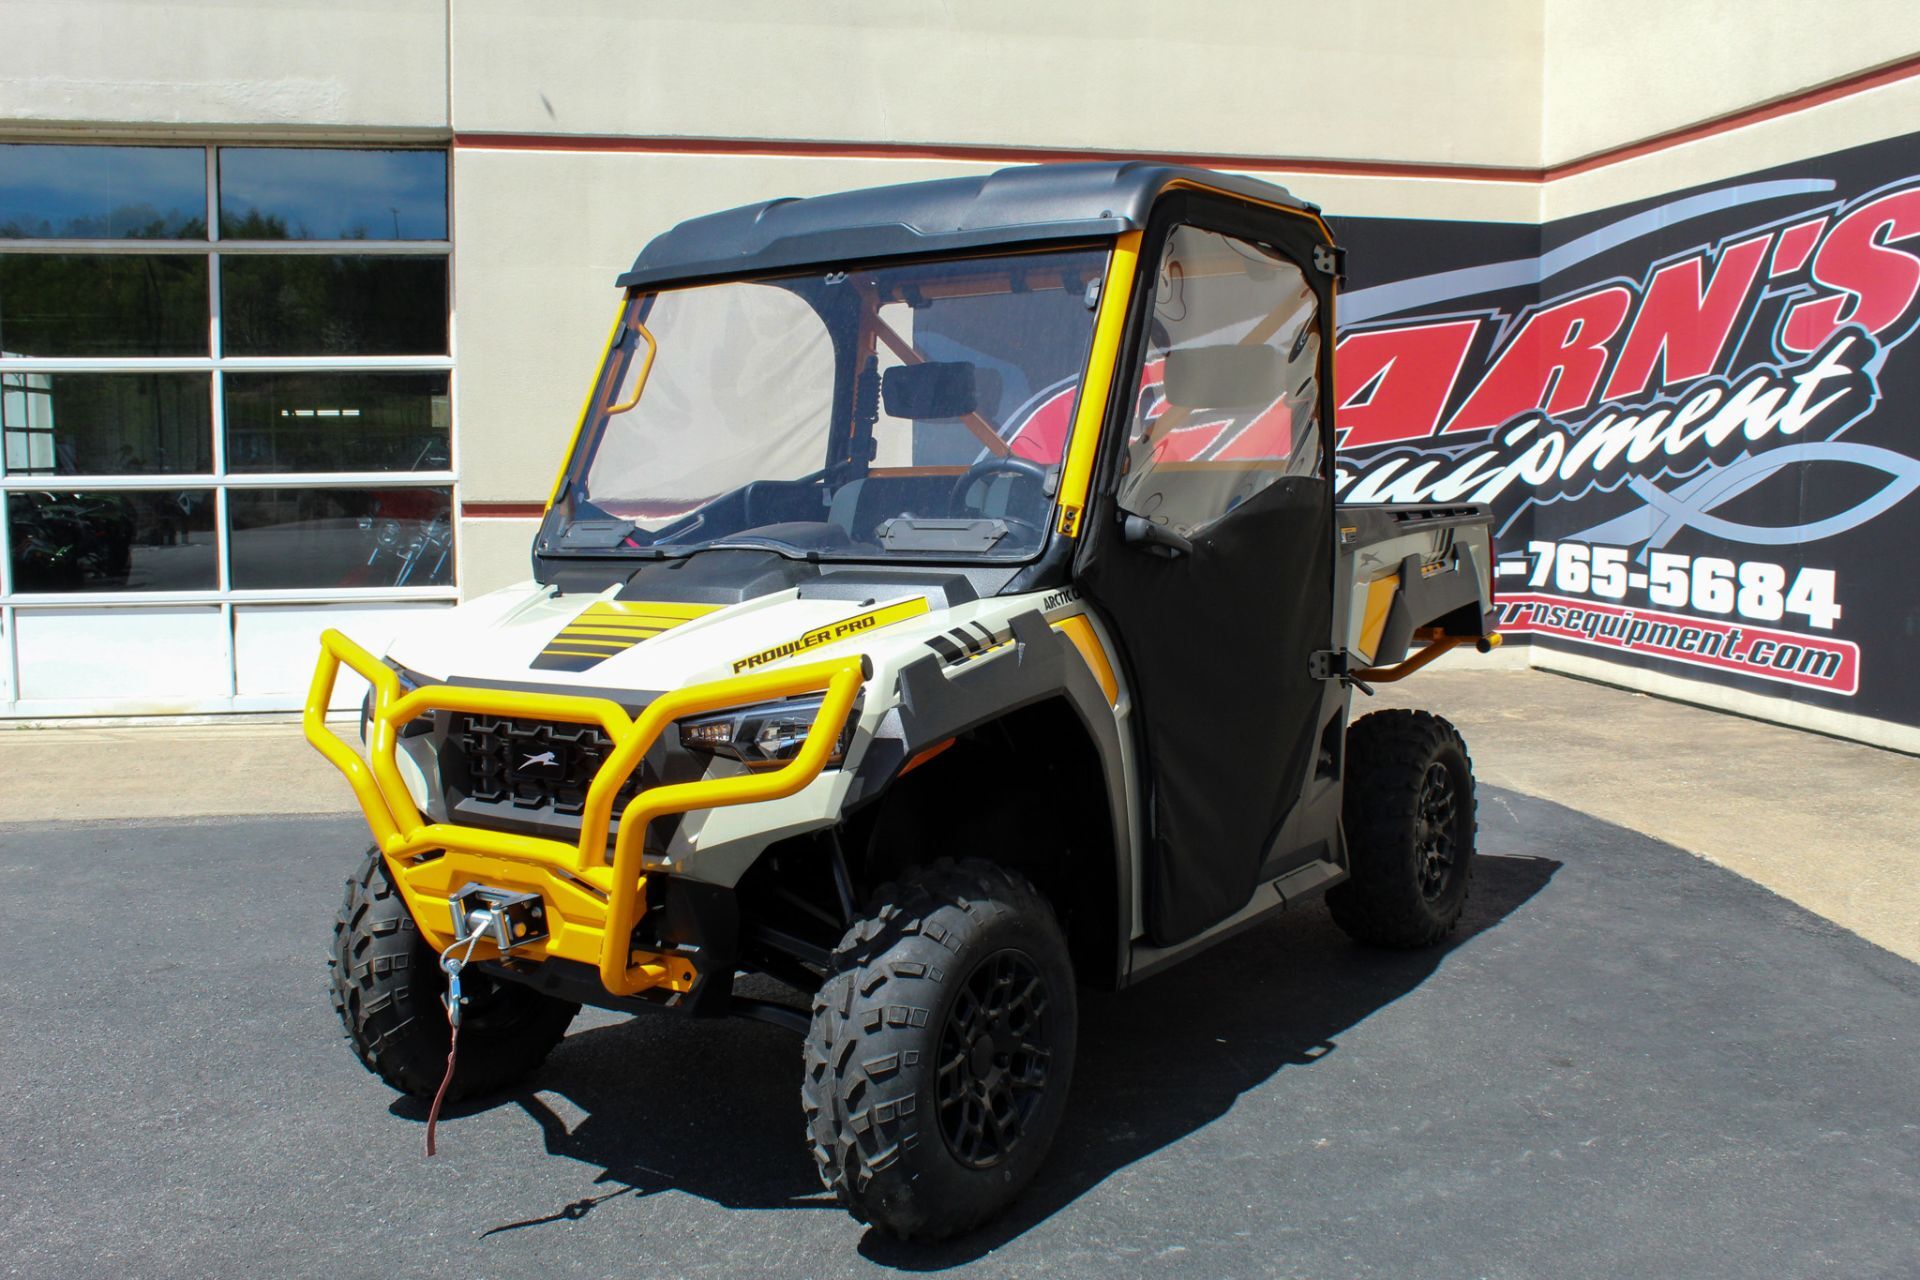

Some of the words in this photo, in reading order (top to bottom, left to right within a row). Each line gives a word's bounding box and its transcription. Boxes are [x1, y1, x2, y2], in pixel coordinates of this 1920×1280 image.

[1334, 335, 1855, 504] uipment
[1043, 590, 1073, 611] ARCTIC
[732, 630, 831, 675] PROWLER
[834, 616, 875, 637] PRO
